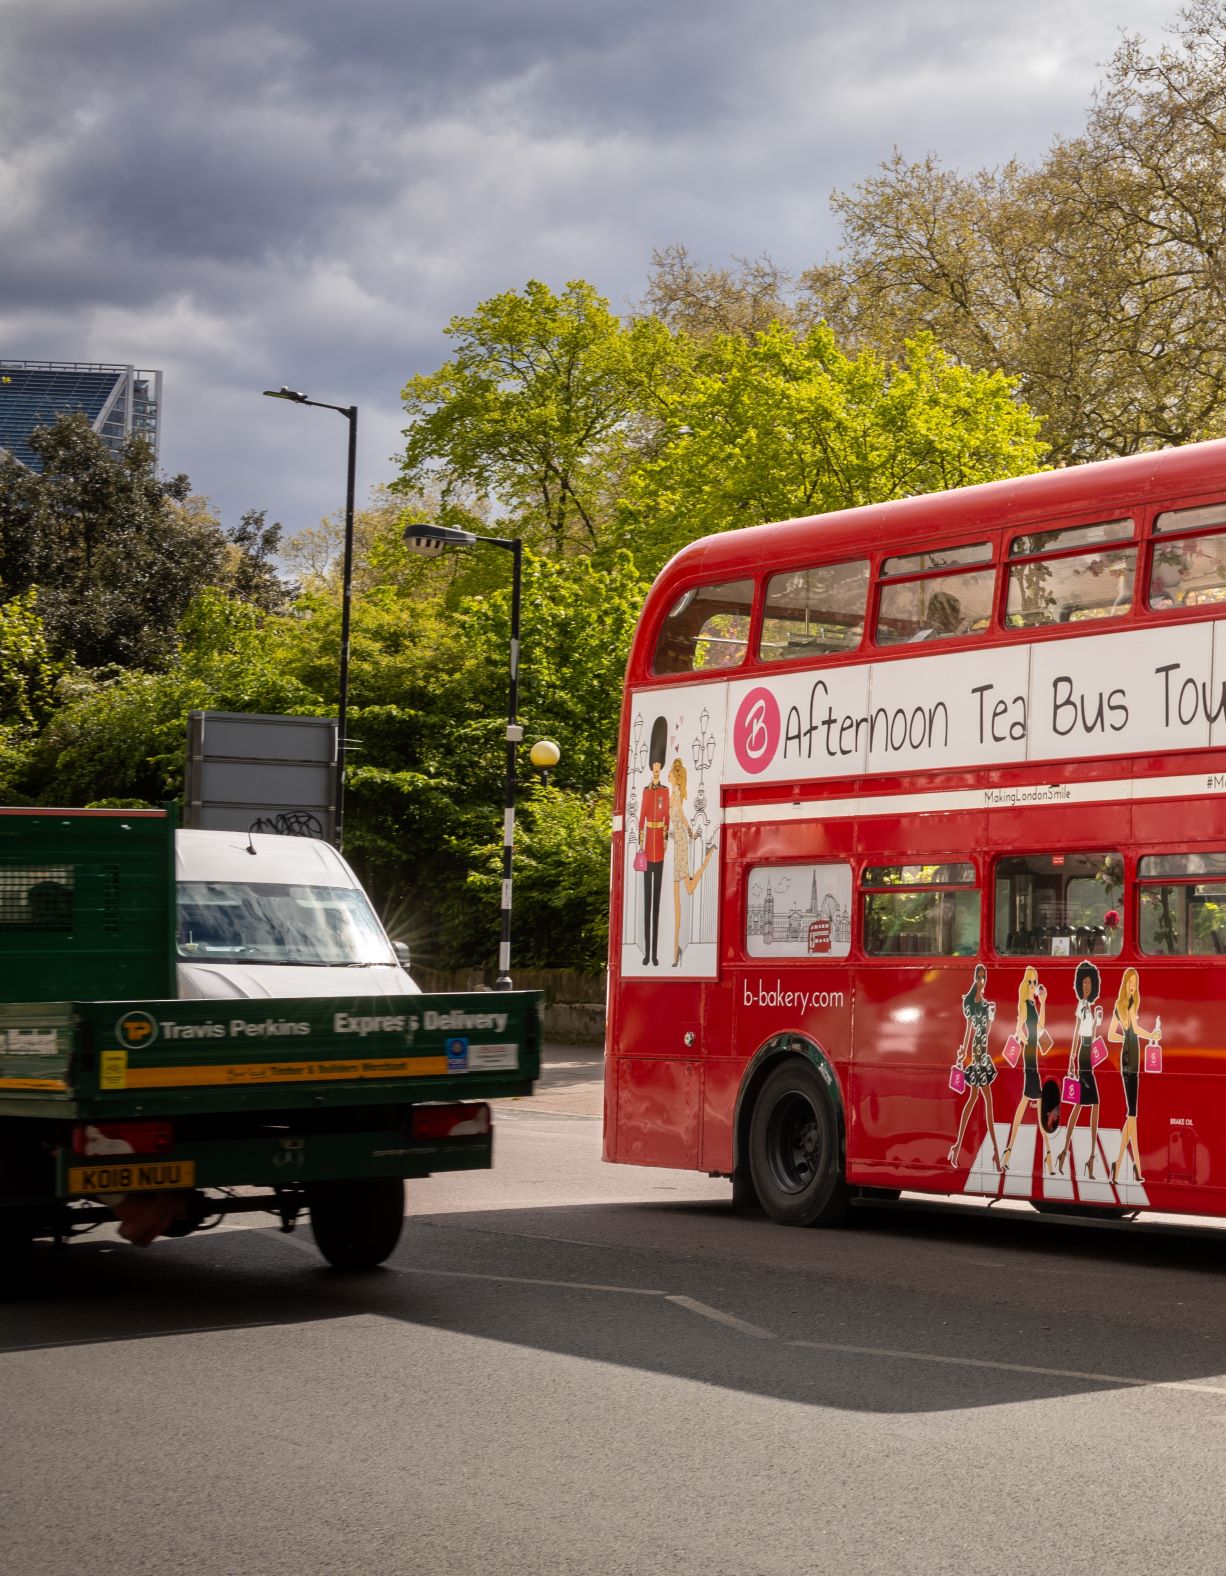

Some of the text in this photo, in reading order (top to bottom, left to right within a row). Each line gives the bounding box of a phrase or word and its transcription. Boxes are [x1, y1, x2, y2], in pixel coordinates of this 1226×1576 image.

[783, 680, 948, 759] Afternoon
[971, 683, 1027, 743] Tea
[1052, 676, 1129, 736] Bus
[743, 978, 844, 1016] b-bakery.com
[159, 1020, 226, 1039] Travis
[229, 1018, 311, 1038] Perkins
[333, 1010, 509, 1037] Express Delivery
[1170, 1117, 1194, 1126] BRAKE OIL
[82, 1164, 182, 1190] KO18 NUU
